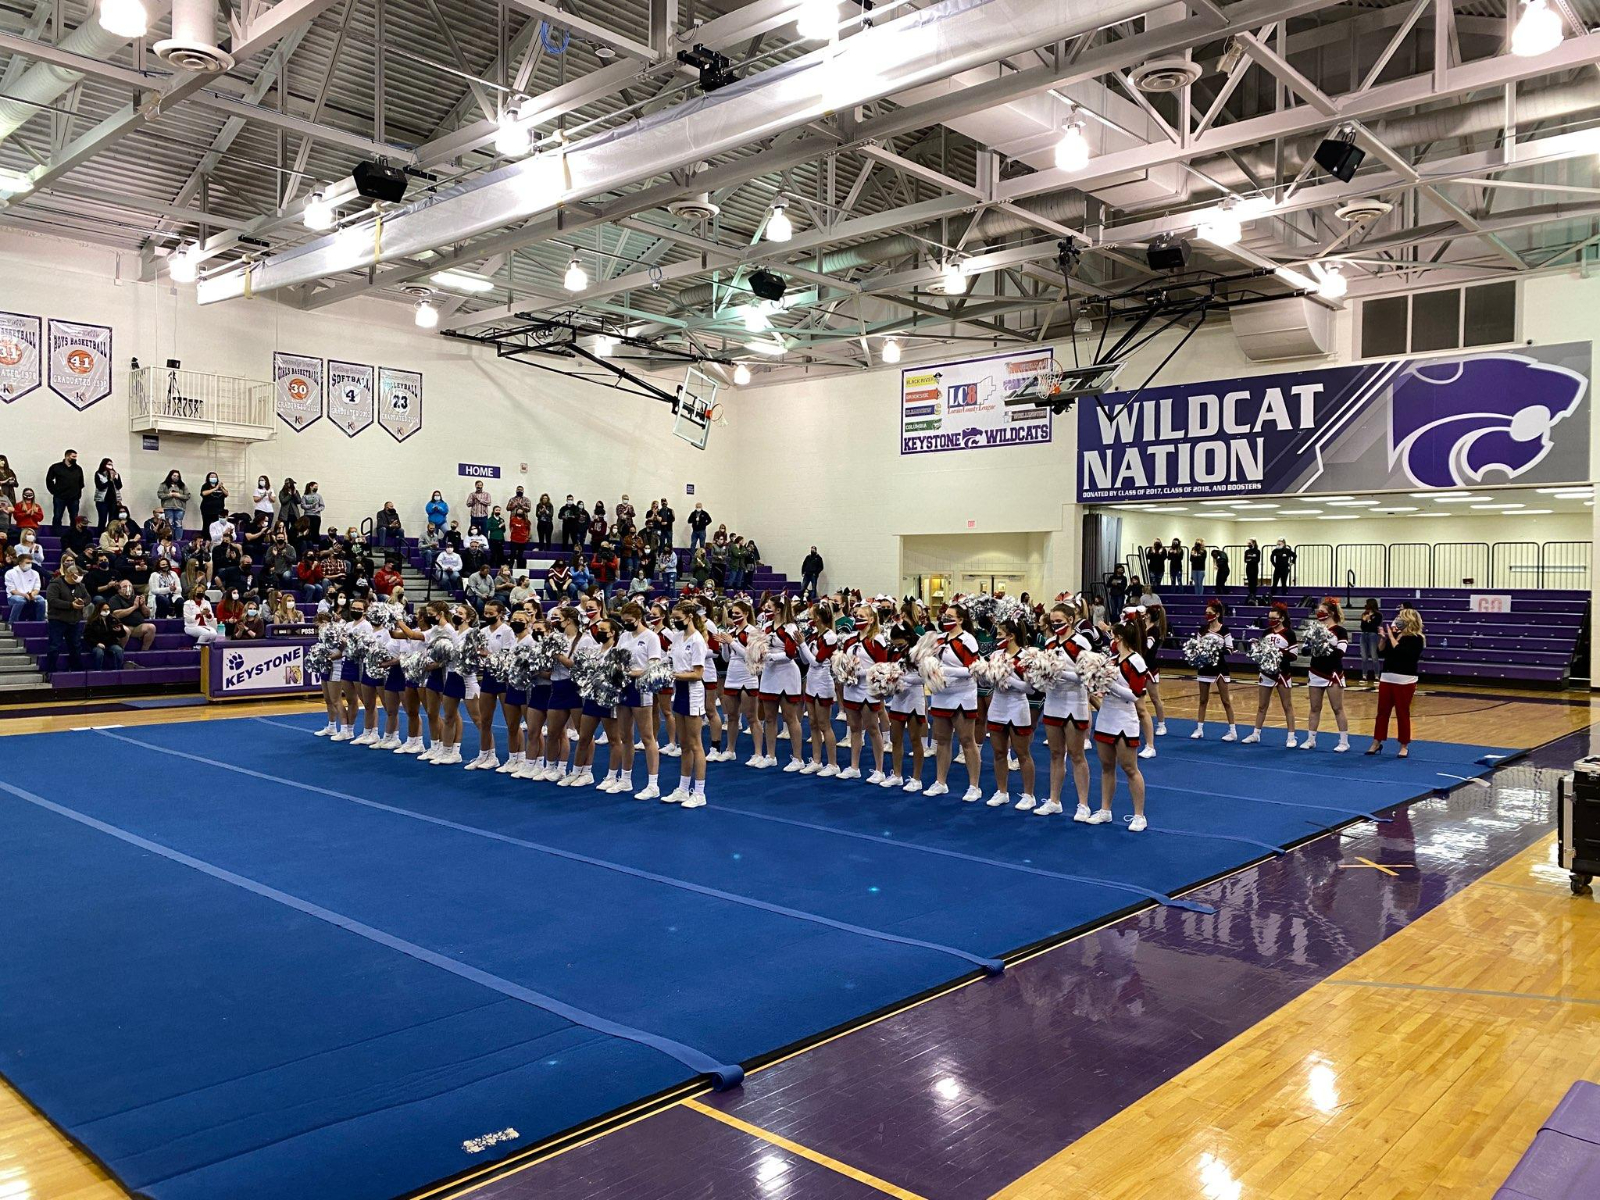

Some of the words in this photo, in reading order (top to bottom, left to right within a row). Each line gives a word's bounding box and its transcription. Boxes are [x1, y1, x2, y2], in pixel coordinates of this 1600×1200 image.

[53, 334, 69, 352] BOYS
[70, 337, 107, 359] BASKETBALL
[70, 356, 90, 368] 41
[290, 384, 307, 394] 30
[331, 373, 371, 391] SOFTBALL
[345, 389, 356, 402] 4
[393, 394, 408, 409] 23
[949, 384, 977, 406] LC8
[1096, 383, 1324, 445] WILDCAT
[903, 432, 961, 451] KEYSTONE
[985, 424, 1049, 444] WILDCATS
[465, 465, 494, 477] HOME
[1082, 437, 1265, 490] NATION
[1163, 486, 1183, 494] CLASS
[1192, 485, 1211, 493] 2018,
[1212, 484, 1226, 492] AND
[1227, 483, 1262, 491] BOOSTERS
[225, 647, 301, 689] KEYSTONE
